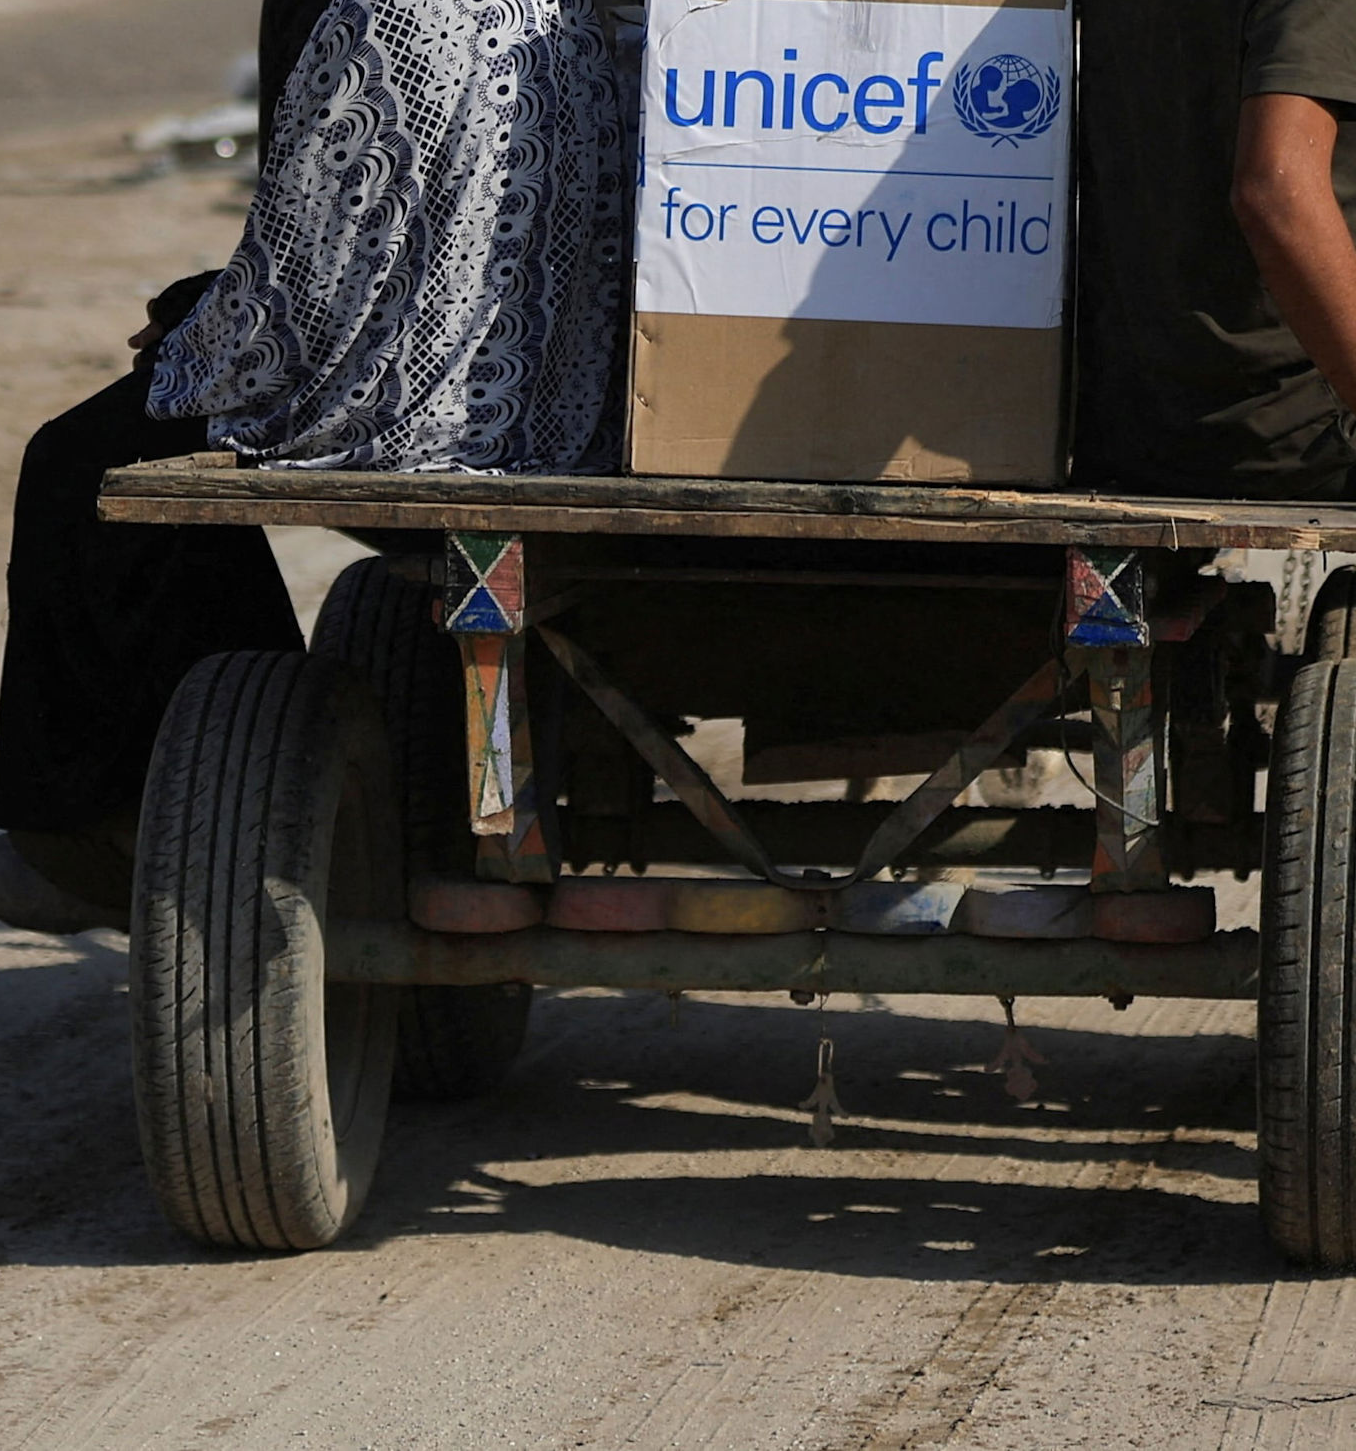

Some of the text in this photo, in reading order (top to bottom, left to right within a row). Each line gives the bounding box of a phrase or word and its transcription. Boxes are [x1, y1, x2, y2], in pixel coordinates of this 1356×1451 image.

[664, 48, 942, 135] unicef
[660, 186, 1052, 262] for every child
